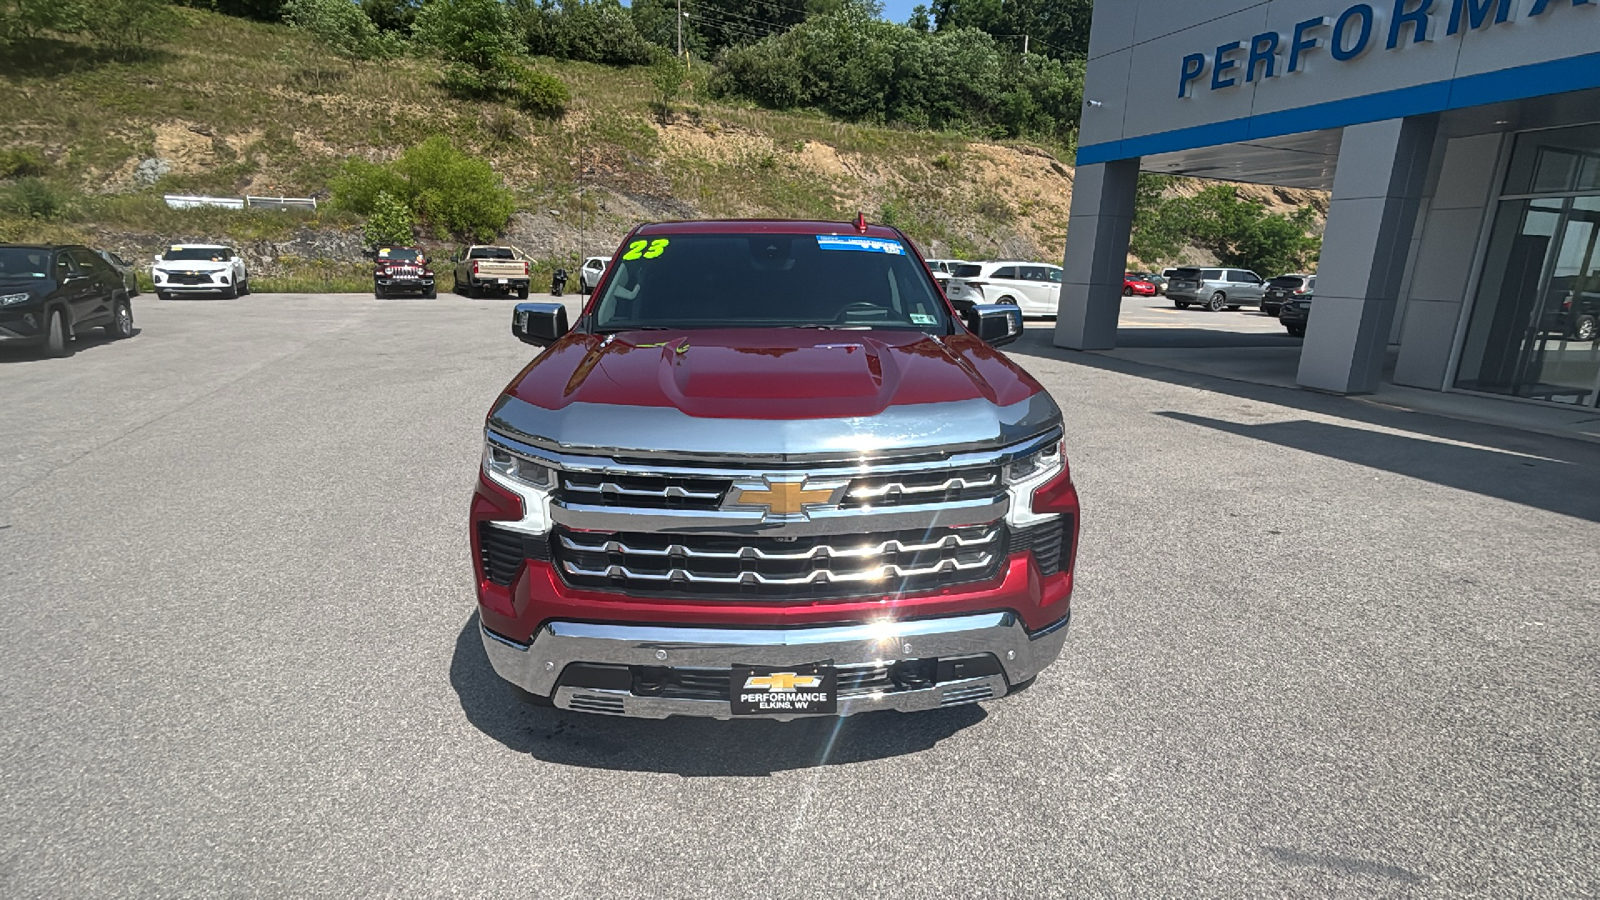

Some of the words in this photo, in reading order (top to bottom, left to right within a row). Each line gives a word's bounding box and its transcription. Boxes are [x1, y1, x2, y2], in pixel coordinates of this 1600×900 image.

[1178, 0, 1590, 98] PERFORM
[622, 239, 669, 260] 23
[740, 693, 827, 702] PERFORMANCE
